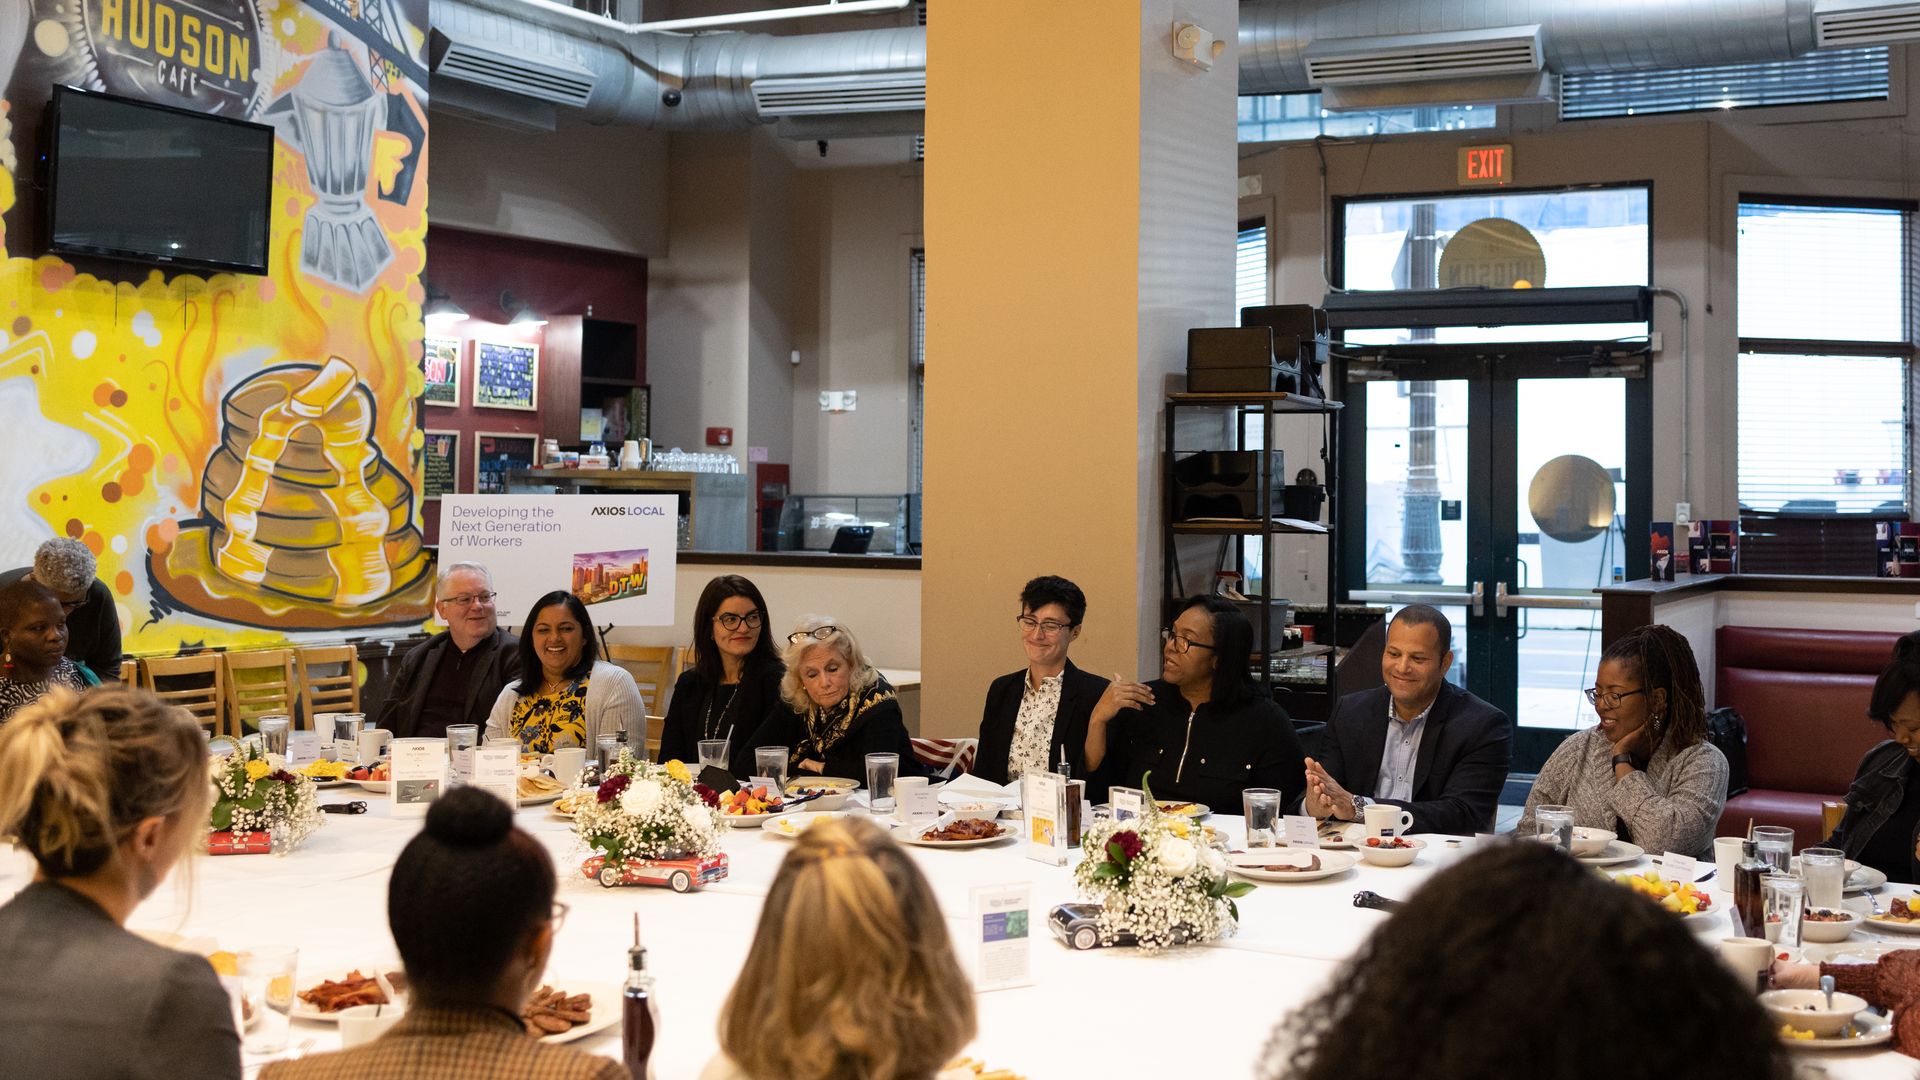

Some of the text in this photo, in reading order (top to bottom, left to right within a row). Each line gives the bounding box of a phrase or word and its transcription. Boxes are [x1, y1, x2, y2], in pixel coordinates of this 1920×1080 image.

[102, 0, 250, 82] HUDSON
[157, 59, 198, 96] CAFE
[1467, 149, 1504, 179] EXIT
[452, 505, 554, 520] Developing the
[591, 507, 665, 516] AXIOS LOCAL
[451, 520, 561, 532] Next Generation
[450, 535, 522, 547] of Workers
[608, 572, 647, 598] DTW
